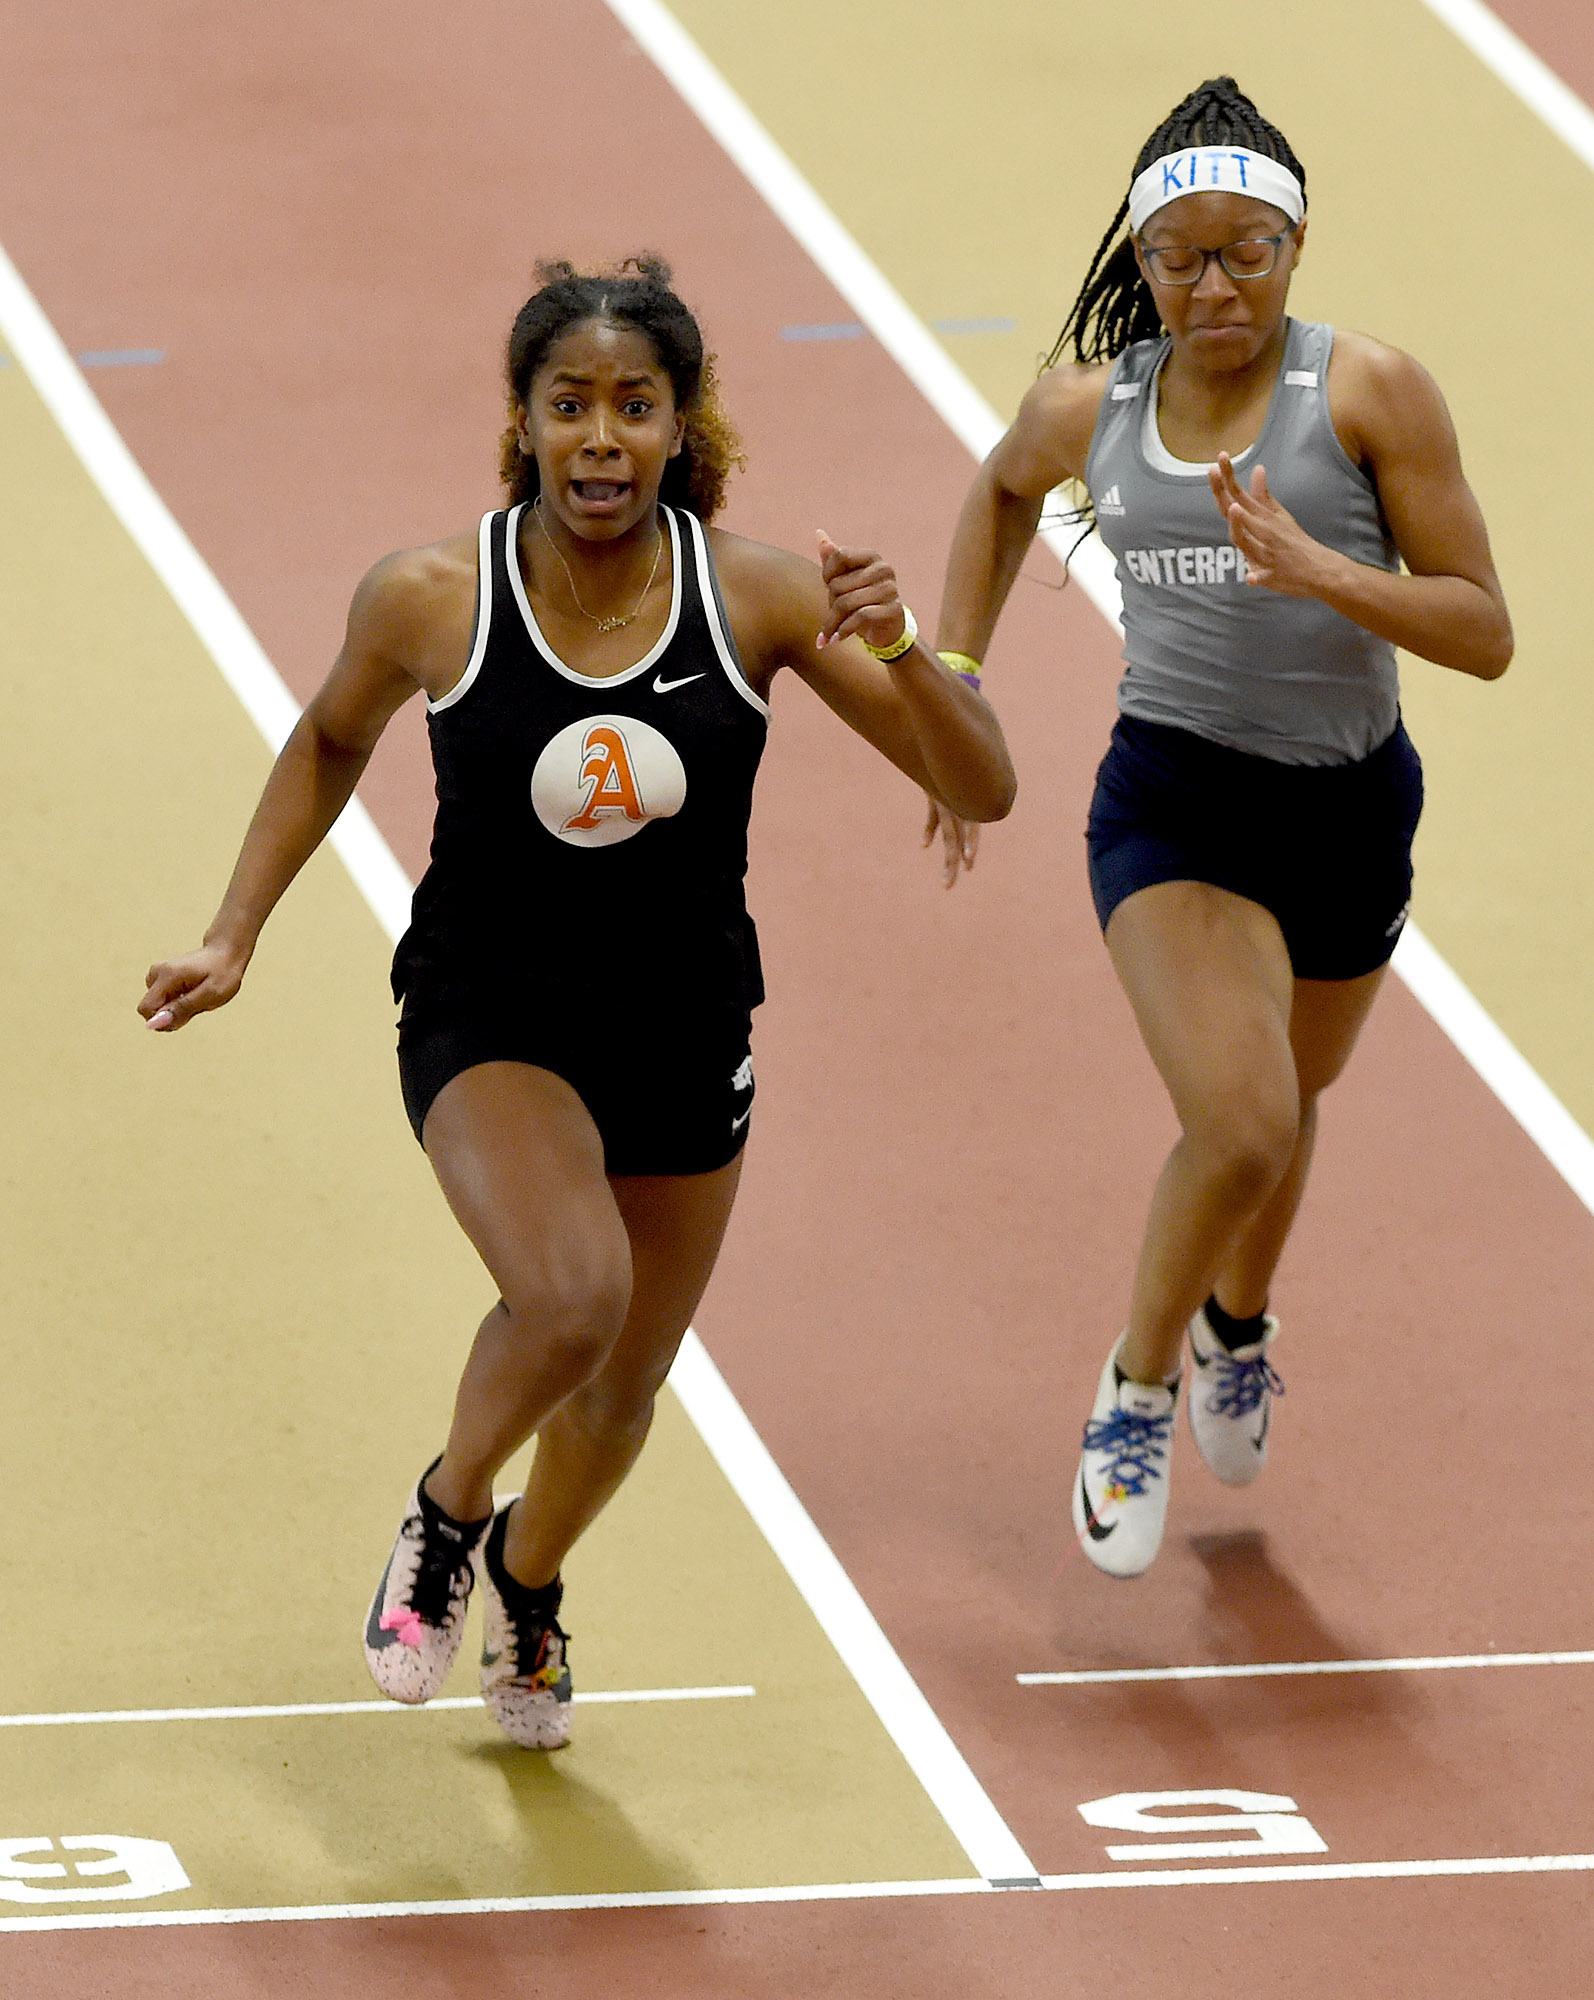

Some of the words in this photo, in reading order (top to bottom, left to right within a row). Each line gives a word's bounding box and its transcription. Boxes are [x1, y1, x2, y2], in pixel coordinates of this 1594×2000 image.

[1162, 152, 1250, 197] KITT
[558, 721, 647, 834] A
[1076, 1788, 1330, 1862] 5
